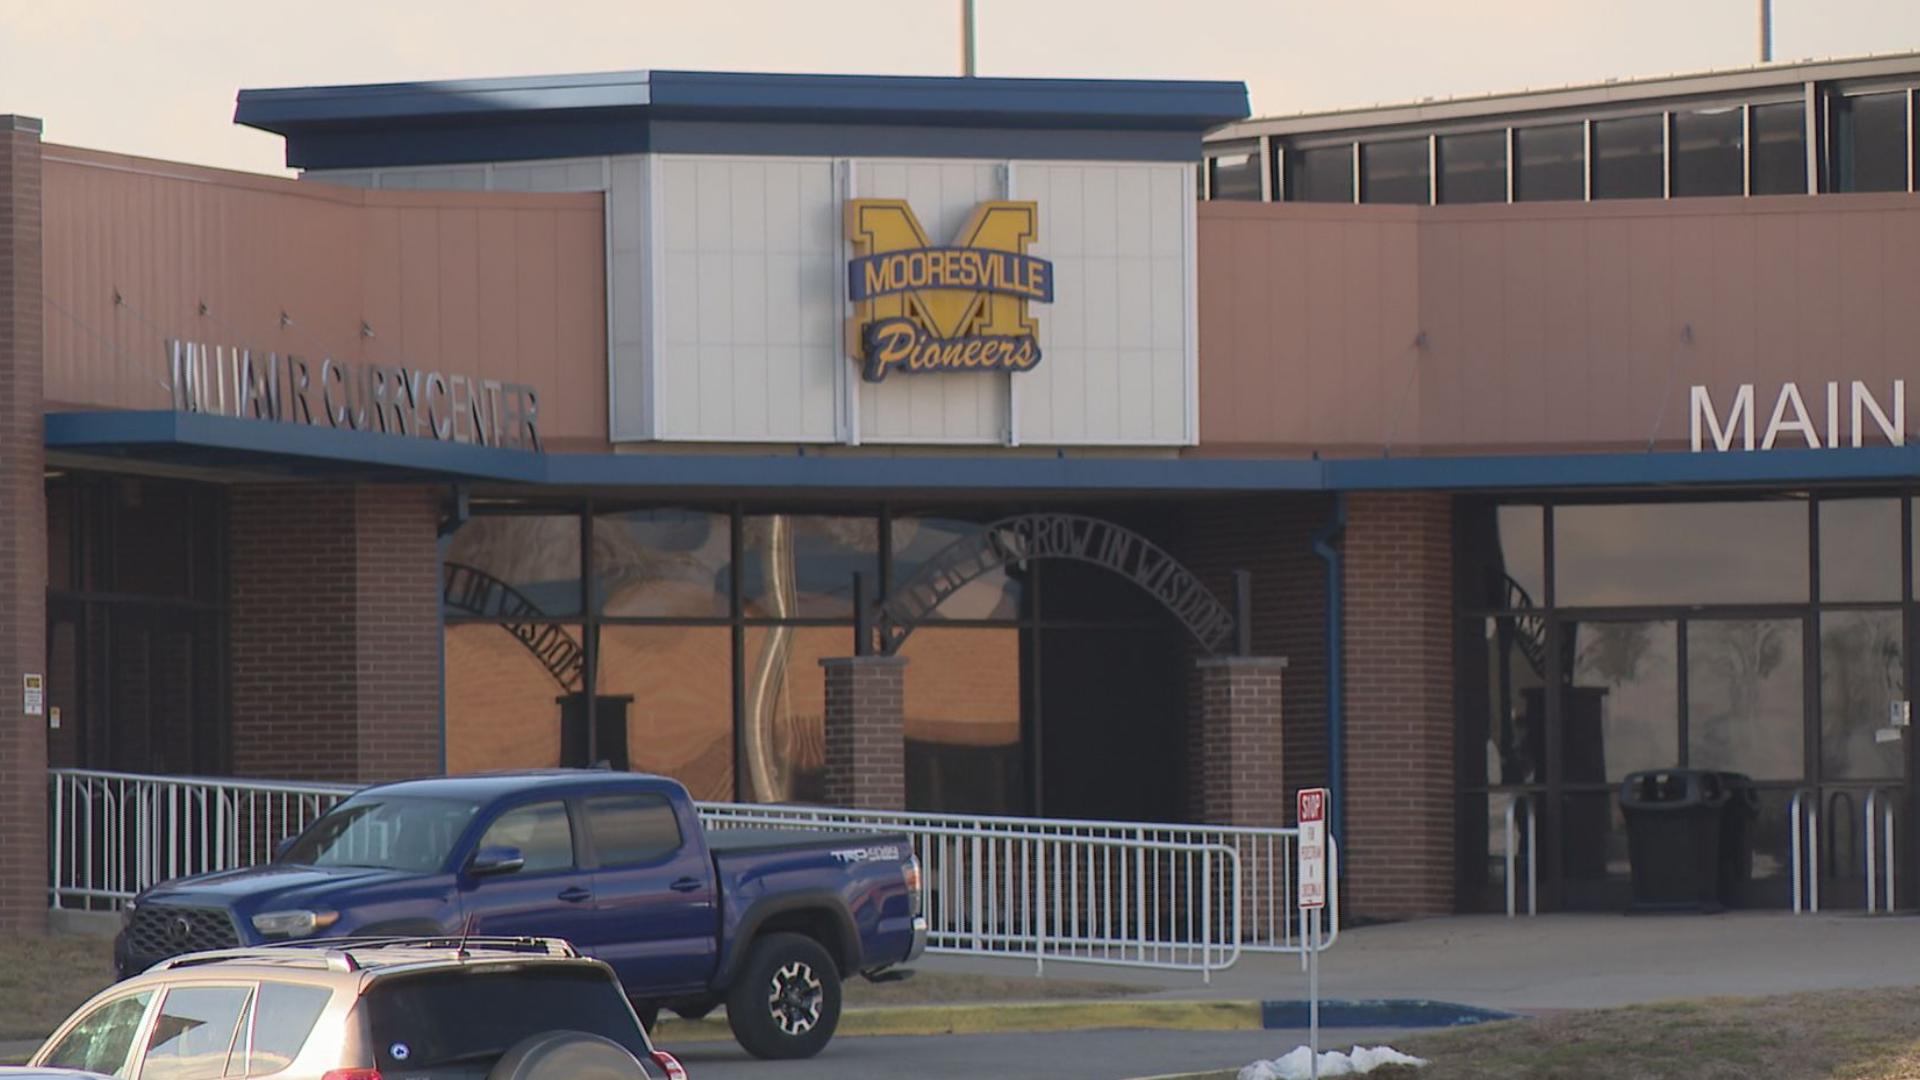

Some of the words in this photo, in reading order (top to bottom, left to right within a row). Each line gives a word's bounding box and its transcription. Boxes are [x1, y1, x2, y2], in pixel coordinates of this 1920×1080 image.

[864, 252, 1045, 296] MOORESVILLE
[876, 321, 1037, 376] Pioneers
[321, 357, 424, 439] CURRY
[426, 371, 543, 454] CENTER
[1691, 379, 1905, 453] MAIN
[1013, 516, 1096, 558] GROW
[1098, 525, 1134, 572] IN
[1134, 543, 1234, 652] WISDOM
[1301, 793, 1321, 820] STOP
